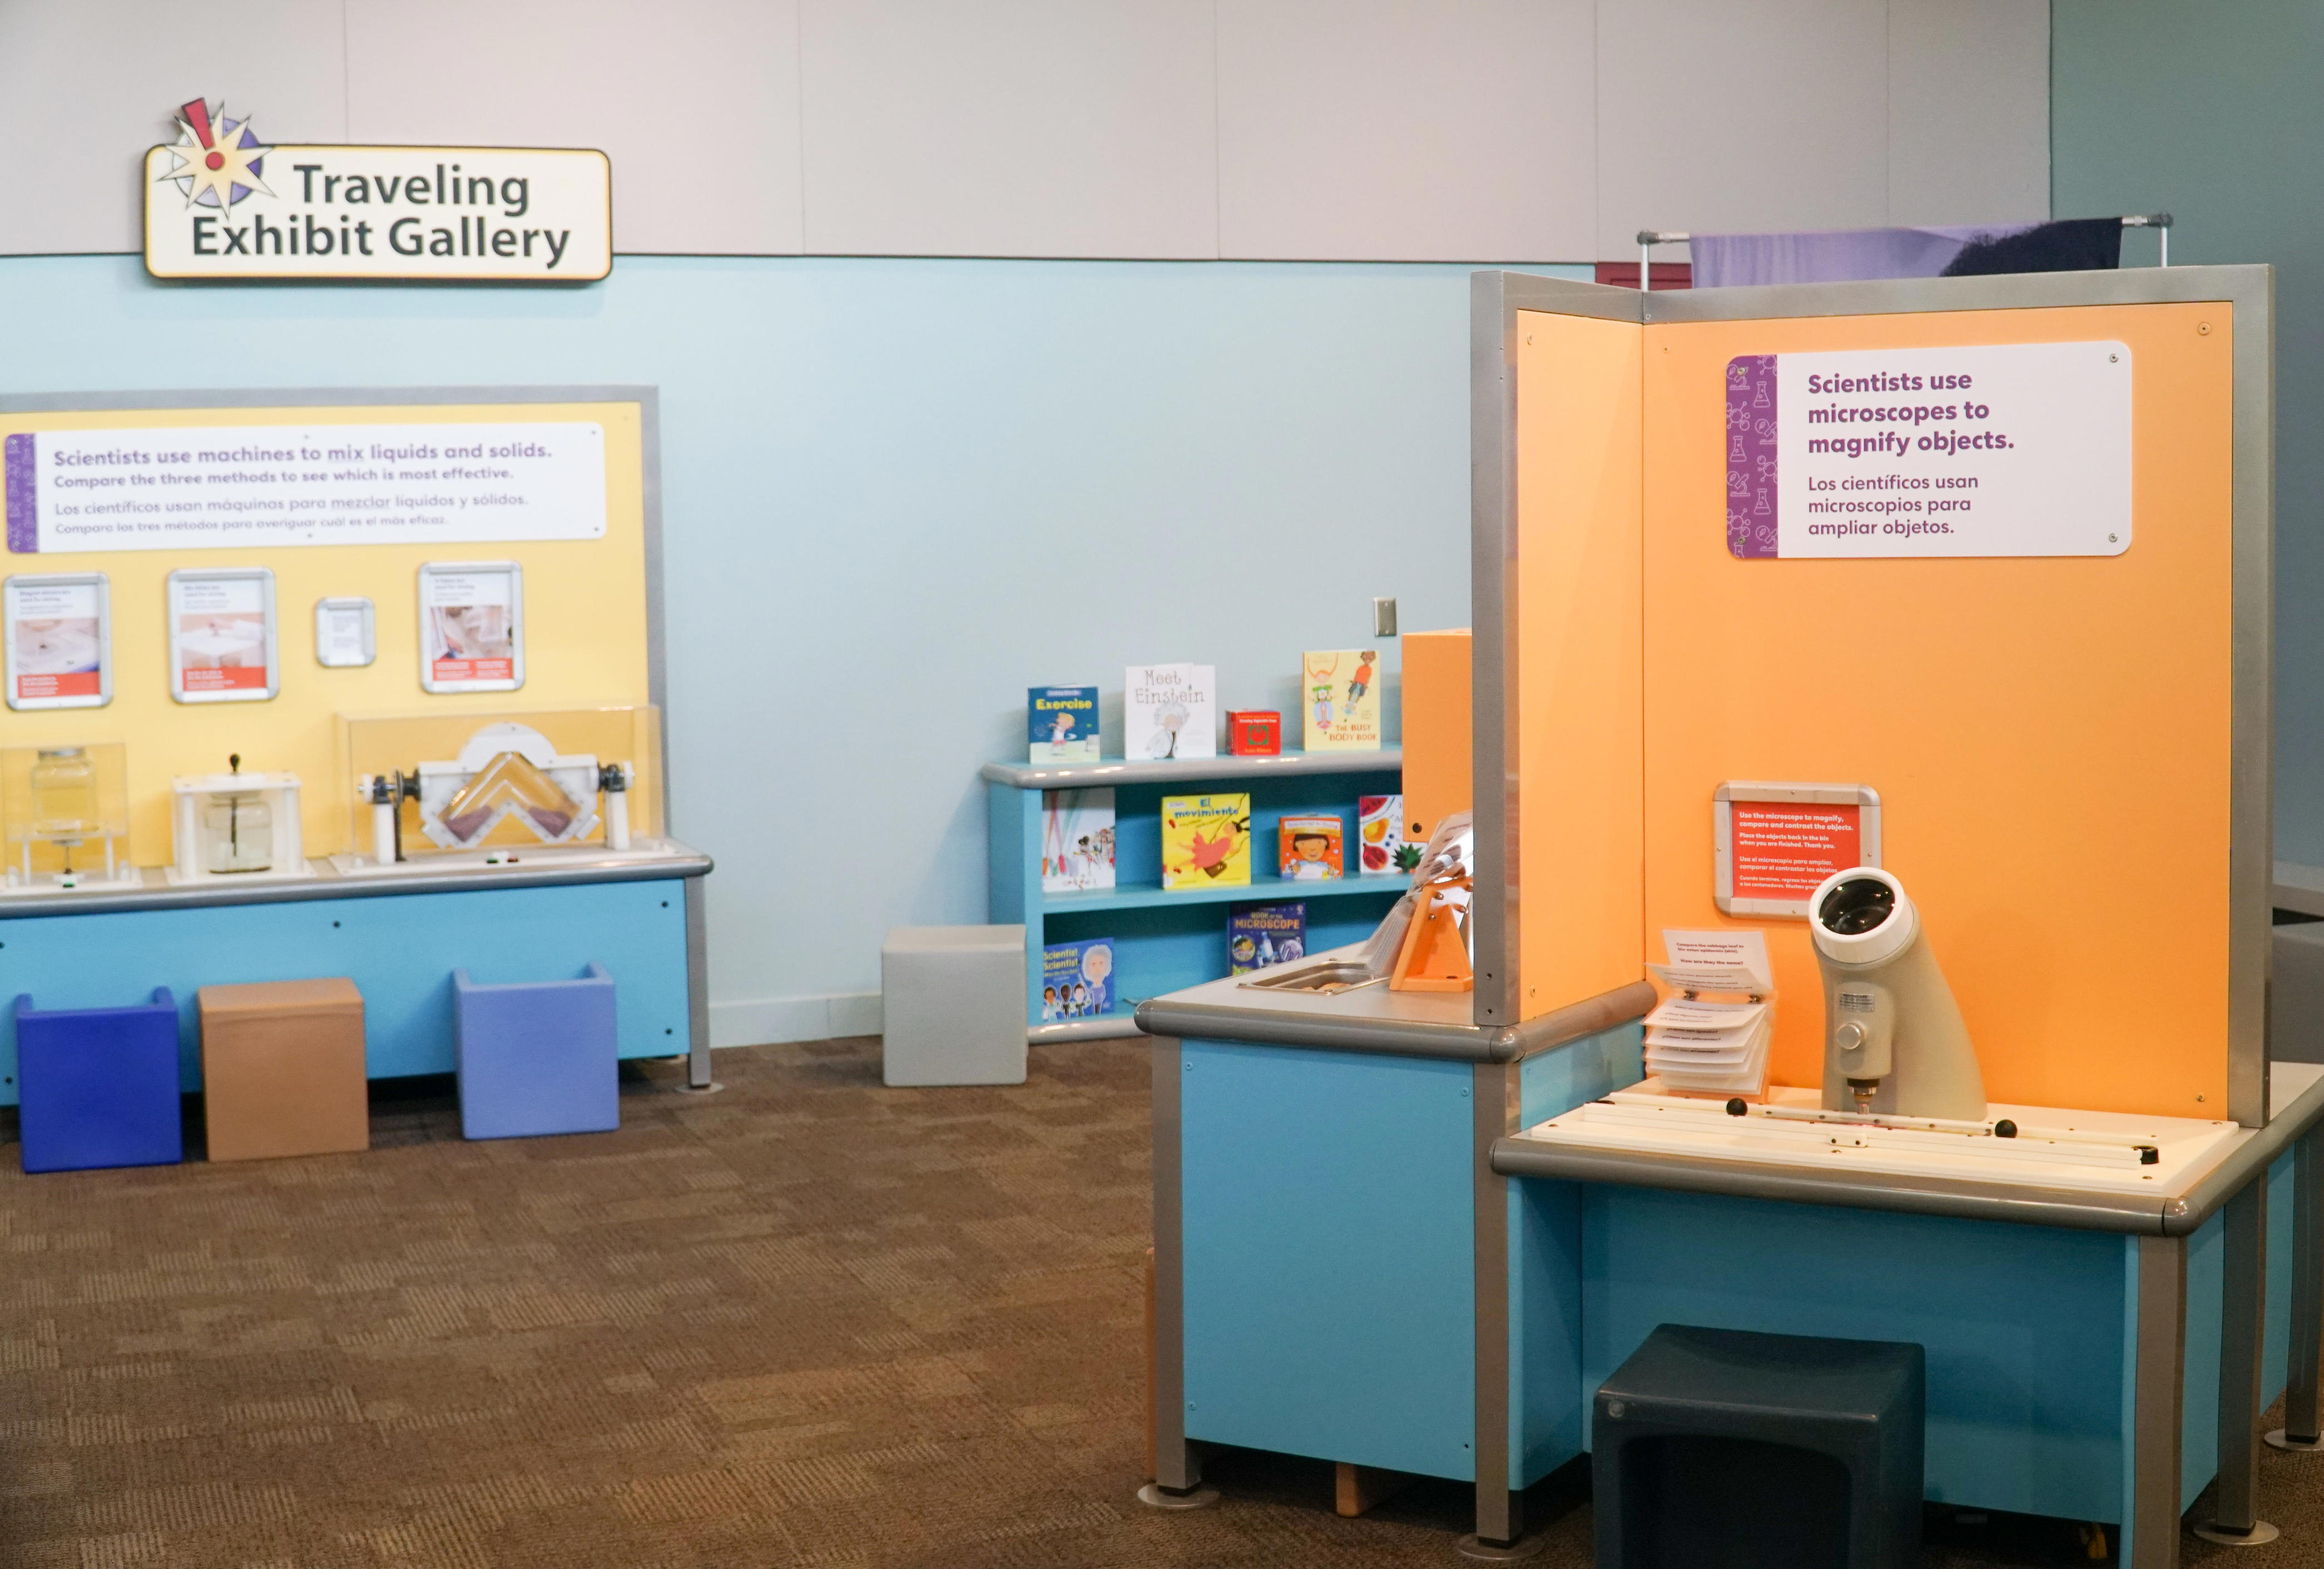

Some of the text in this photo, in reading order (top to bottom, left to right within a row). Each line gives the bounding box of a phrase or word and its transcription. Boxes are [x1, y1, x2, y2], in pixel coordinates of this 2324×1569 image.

[293, 164, 529, 216] Traveling
[193, 215, 571, 269] Exhibit Gallery
[1808, 371, 1972, 393] Scientists use
[1808, 400, 1990, 425] microscopes to
[1808, 430, 2014, 458] magnify objects.
[54, 443, 552, 466] Scientists use machines to mix liquids and solids.
[54, 467, 514, 490] Compare the three methods to see which is most effective.
[1808, 474, 1978, 491] Los científicos usan
[56, 494, 529, 515] Los científicos usan máquinas para mezclar líquidos y sólidos.
[1808, 498, 1971, 515] microscopios para
[56, 523, 112, 535] Compara
[117, 523, 133, 532] los
[138, 522, 161, 531] tres
[166, 519, 218, 530] métodos
[223, 521, 252, 529] para
[366, 516, 376, 526] el
[1808, 520, 1954, 538] ampliar objetos.
[1144, 669, 1181, 685] Meet
[1036, 698, 1092, 710] Exercise
[1136, 687, 1205, 704] Einstein
[1200, 797, 1211, 807] El
[1175, 807, 1238, 818] movimiento
[1766, 813, 1803, 821] microscope
[1236, 918, 1300, 929] MICROSCOPE
